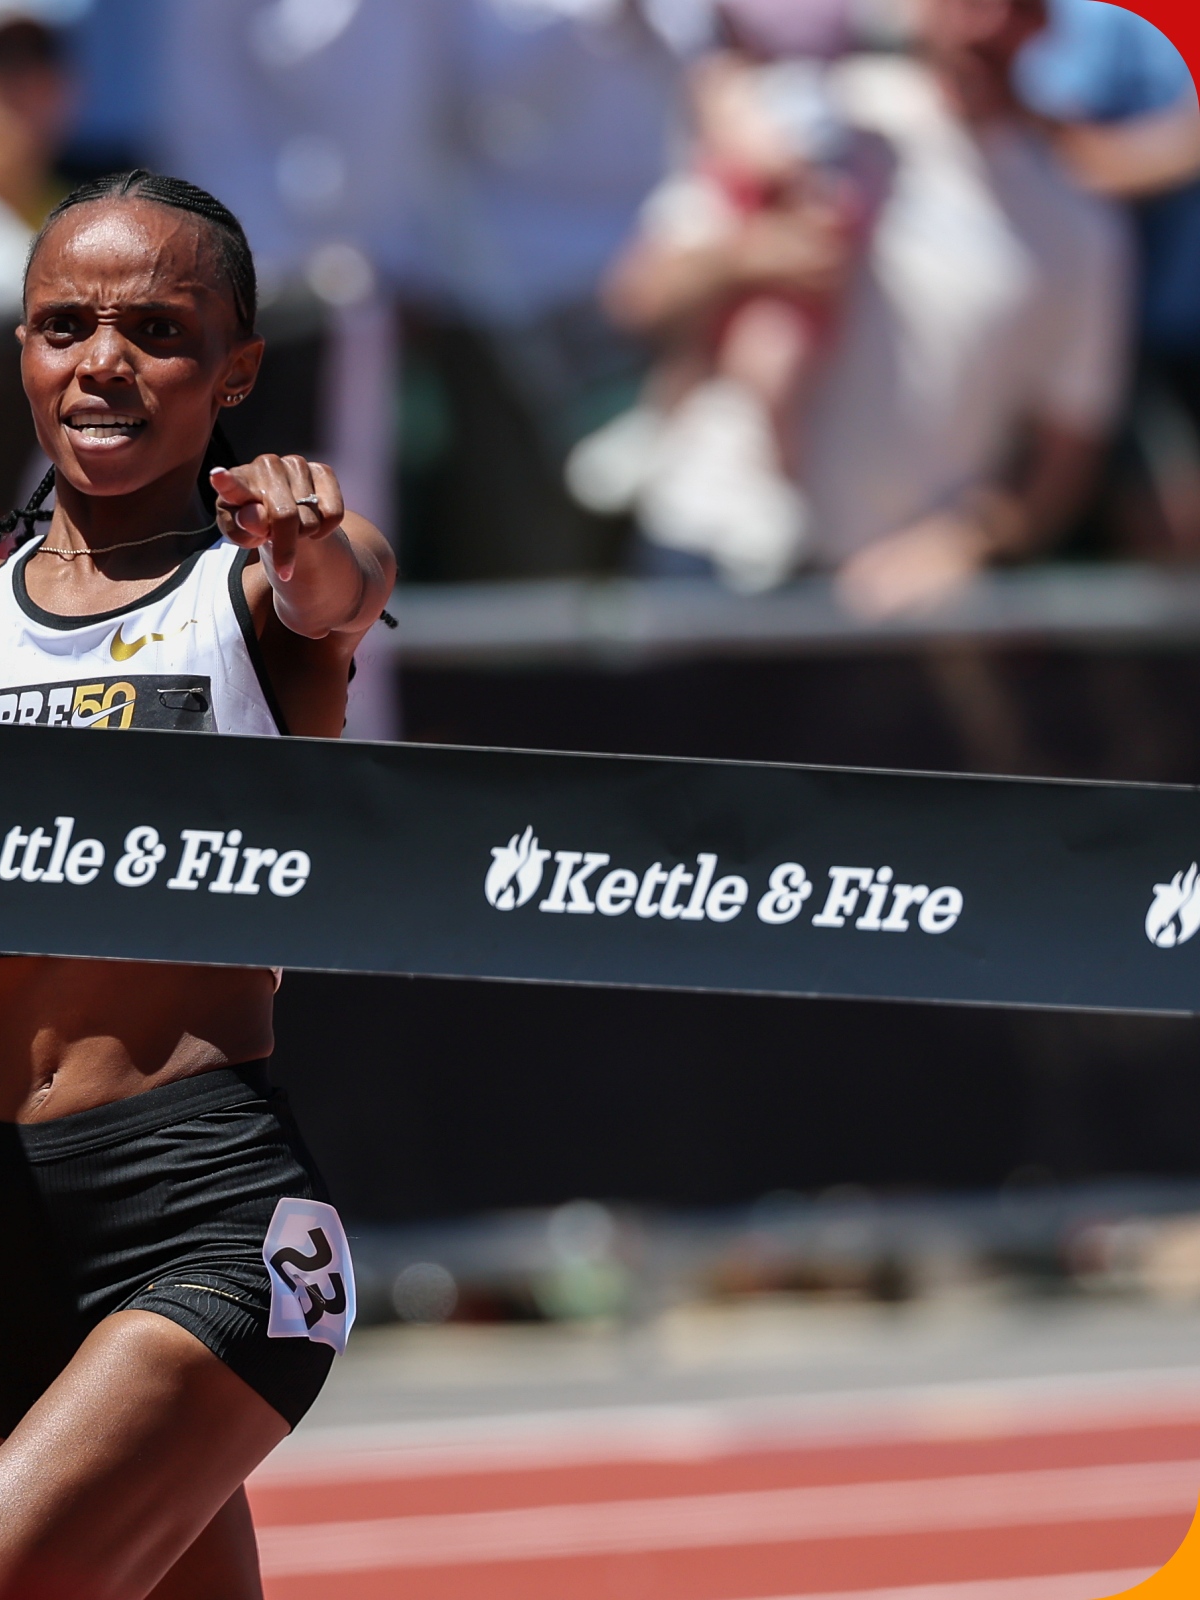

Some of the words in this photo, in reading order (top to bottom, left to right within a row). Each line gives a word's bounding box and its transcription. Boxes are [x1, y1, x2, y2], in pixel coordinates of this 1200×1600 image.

[114, 825, 166, 888] &
[167, 829, 311, 897] Fire
[541, 851, 749, 923] Kettle
[757, 862, 814, 925] &
[811, 865, 963, 934] Fire
